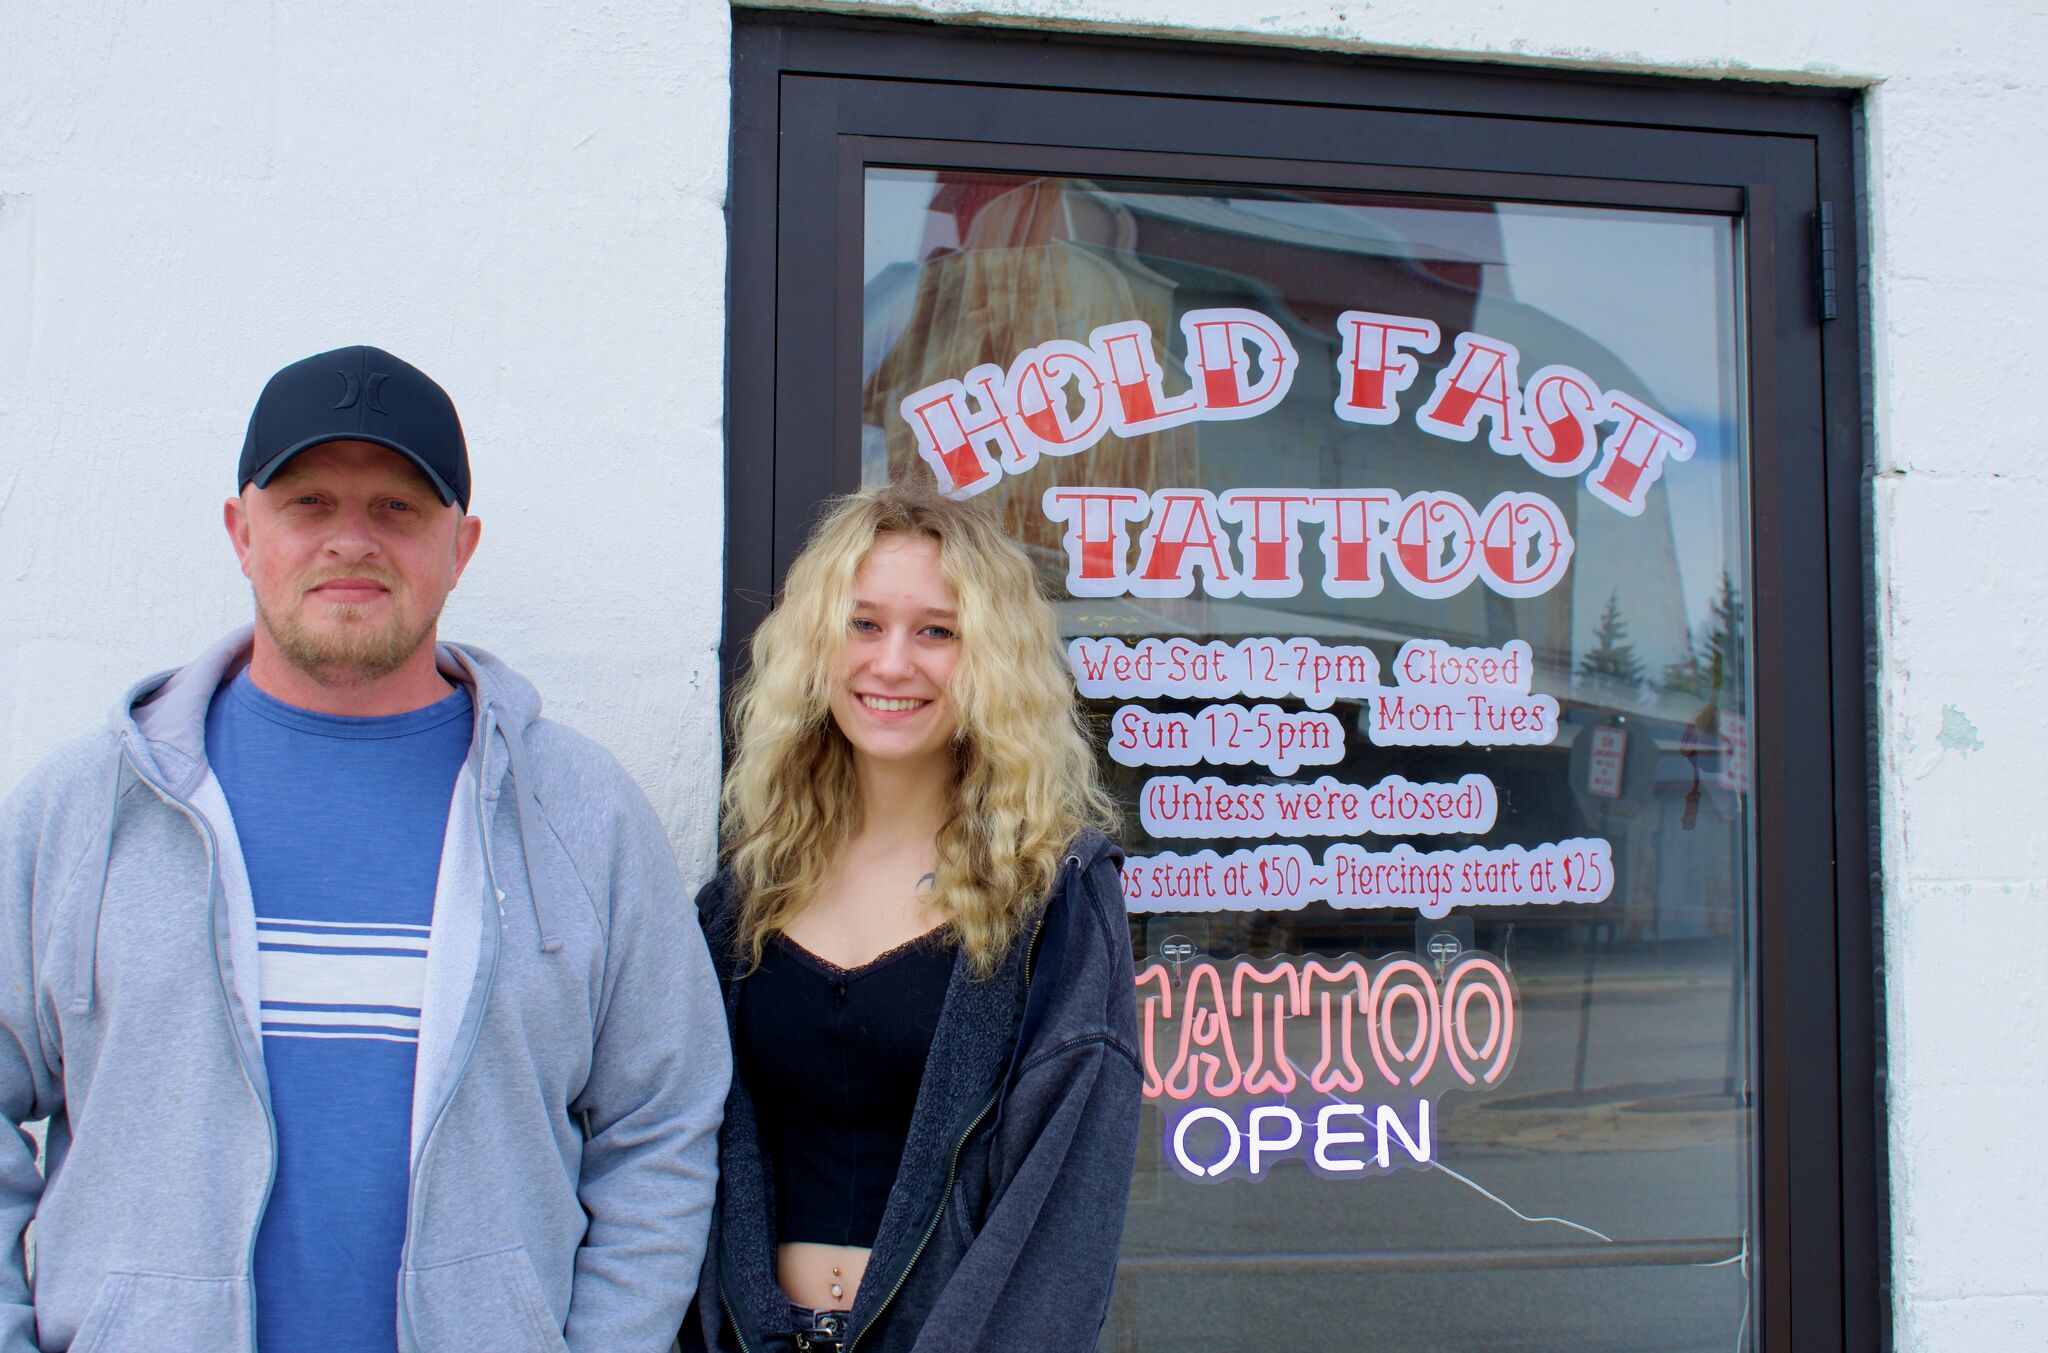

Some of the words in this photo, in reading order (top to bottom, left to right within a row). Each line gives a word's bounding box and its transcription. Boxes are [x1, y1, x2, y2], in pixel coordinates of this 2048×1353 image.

[913, 320, 1287, 490] HOLD
[1342, 319, 1690, 503] FAST
[1055, 493, 1562, 585] TATTOO
[1079, 644, 1228, 682] Wed-Sat
[1243, 645, 1366, 693] 12-7pm
[1402, 649, 1519, 685] Closed
[1118, 712, 1189, 750] Sun
[1205, 712, 1330, 760] 12-5pm
[1378, 695, 1545, 732] Mon-Tues
[1149, 784, 1266, 821] (Unless
[1275, 785, 1360, 821] we're
[1370, 784, 1483, 820] closed)
[1151, 861, 1216, 898] start
[1223, 861, 1253, 897] at
[1259, 856, 1301, 897] $50
[1335, 855, 1454, 907] Piercings
[1461, 858, 1523, 894] start
[1529, 857, 1557, 893] at
[1562, 851, 1602, 892] $25
[1172, 1098, 1433, 1178] OPEN
